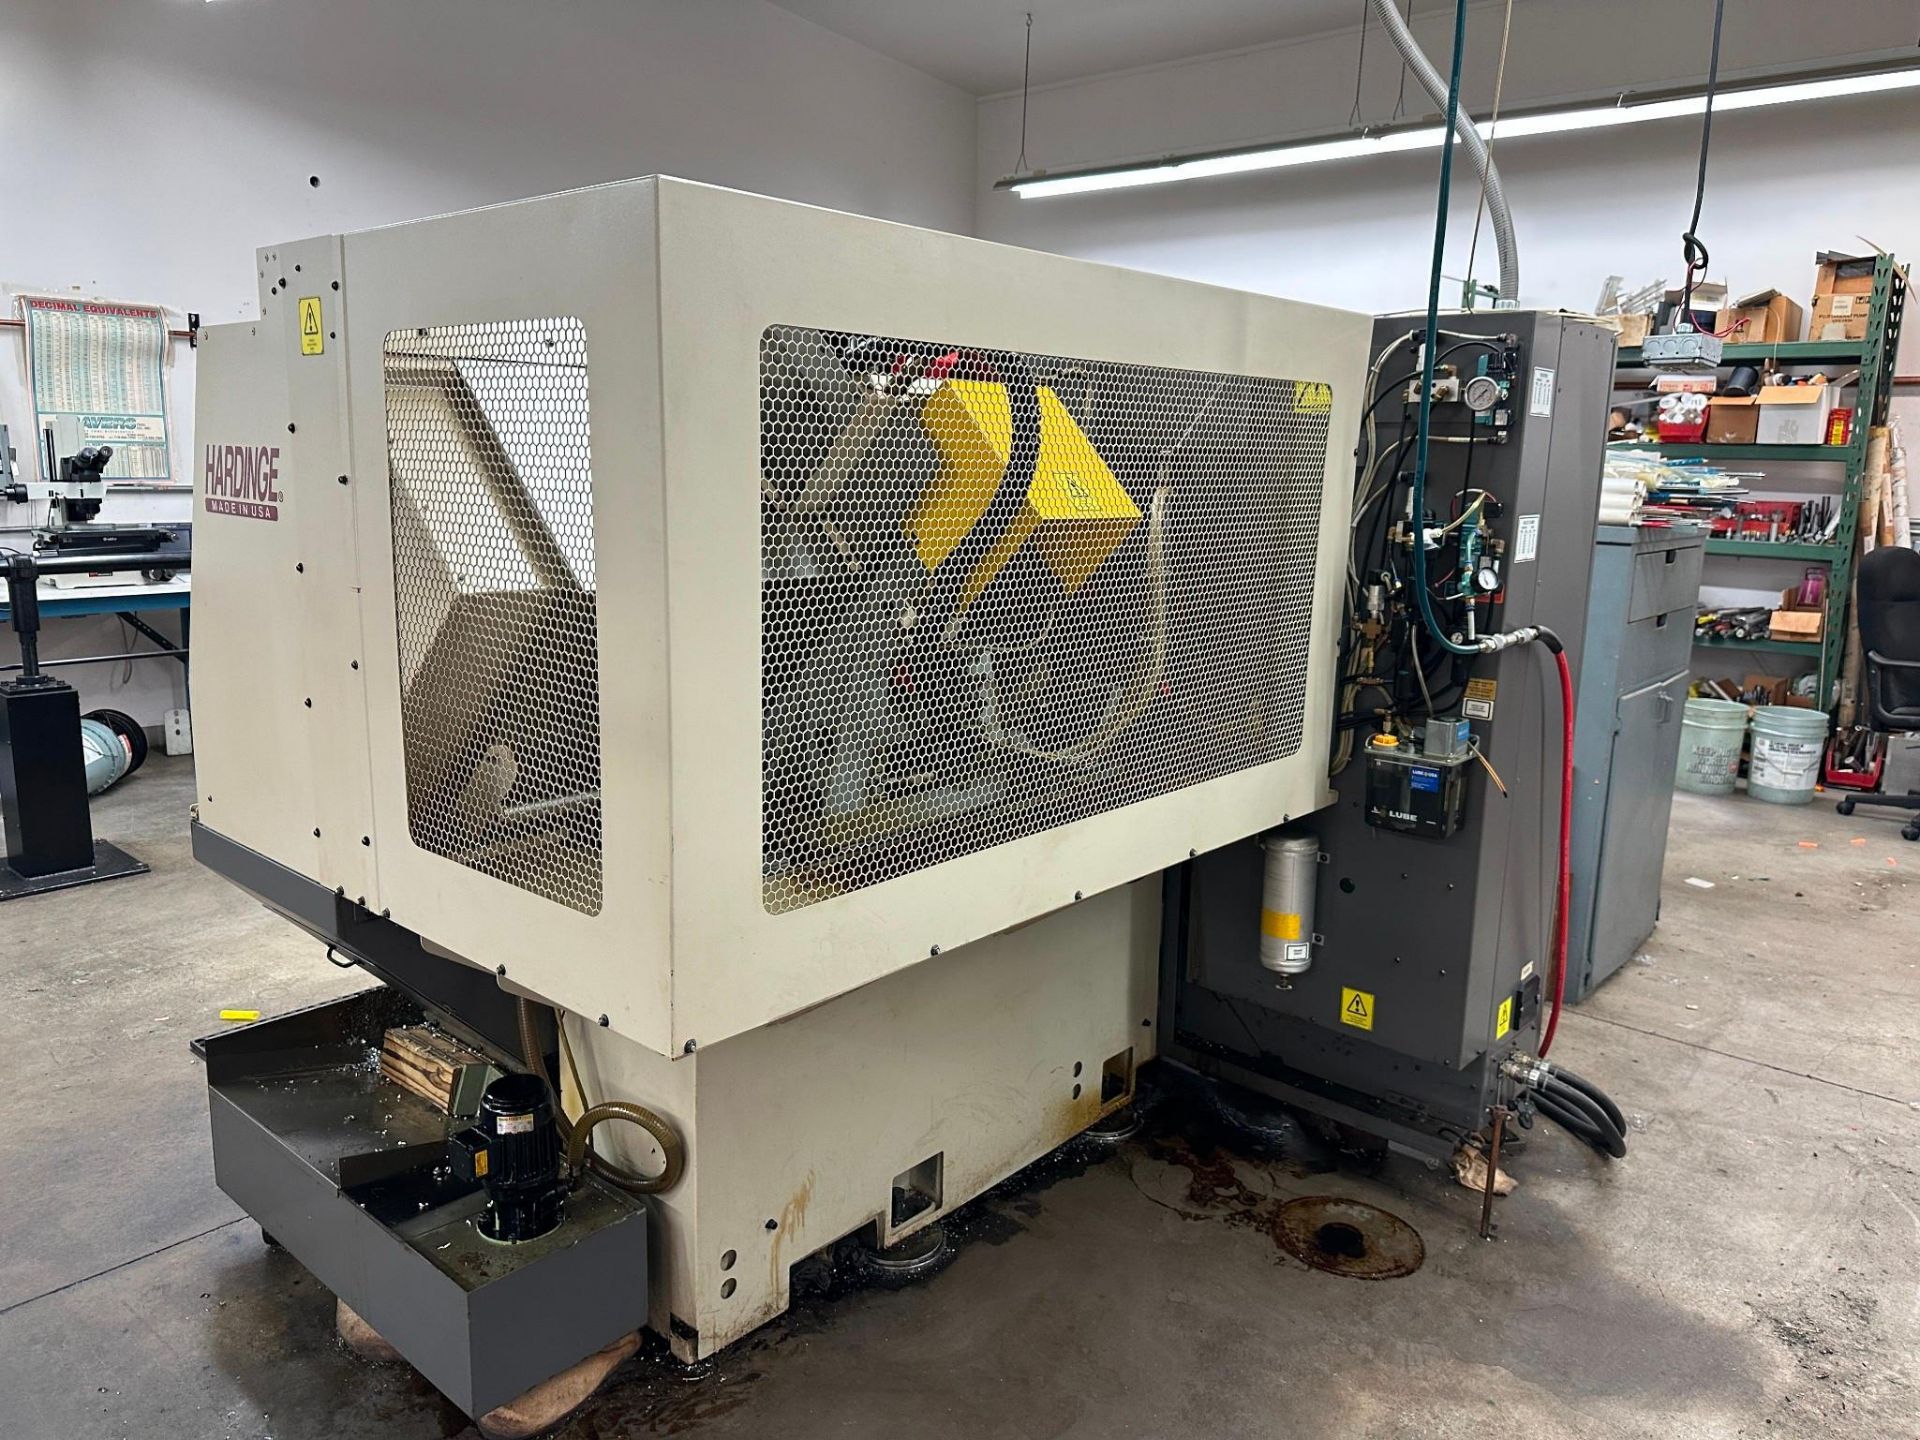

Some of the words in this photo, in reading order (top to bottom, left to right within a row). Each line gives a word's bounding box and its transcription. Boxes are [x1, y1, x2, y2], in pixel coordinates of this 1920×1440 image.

[30, 300, 80, 312] DECIMAL
[83, 303, 158, 319] EQUIVALENTS
[205, 444, 279, 502] HARDINGE
[211, 500, 236, 514] MADE
[239, 503, 248, 515] IN
[251, 505, 271, 518] USA
[1389, 810, 1417, 822] LUBE
